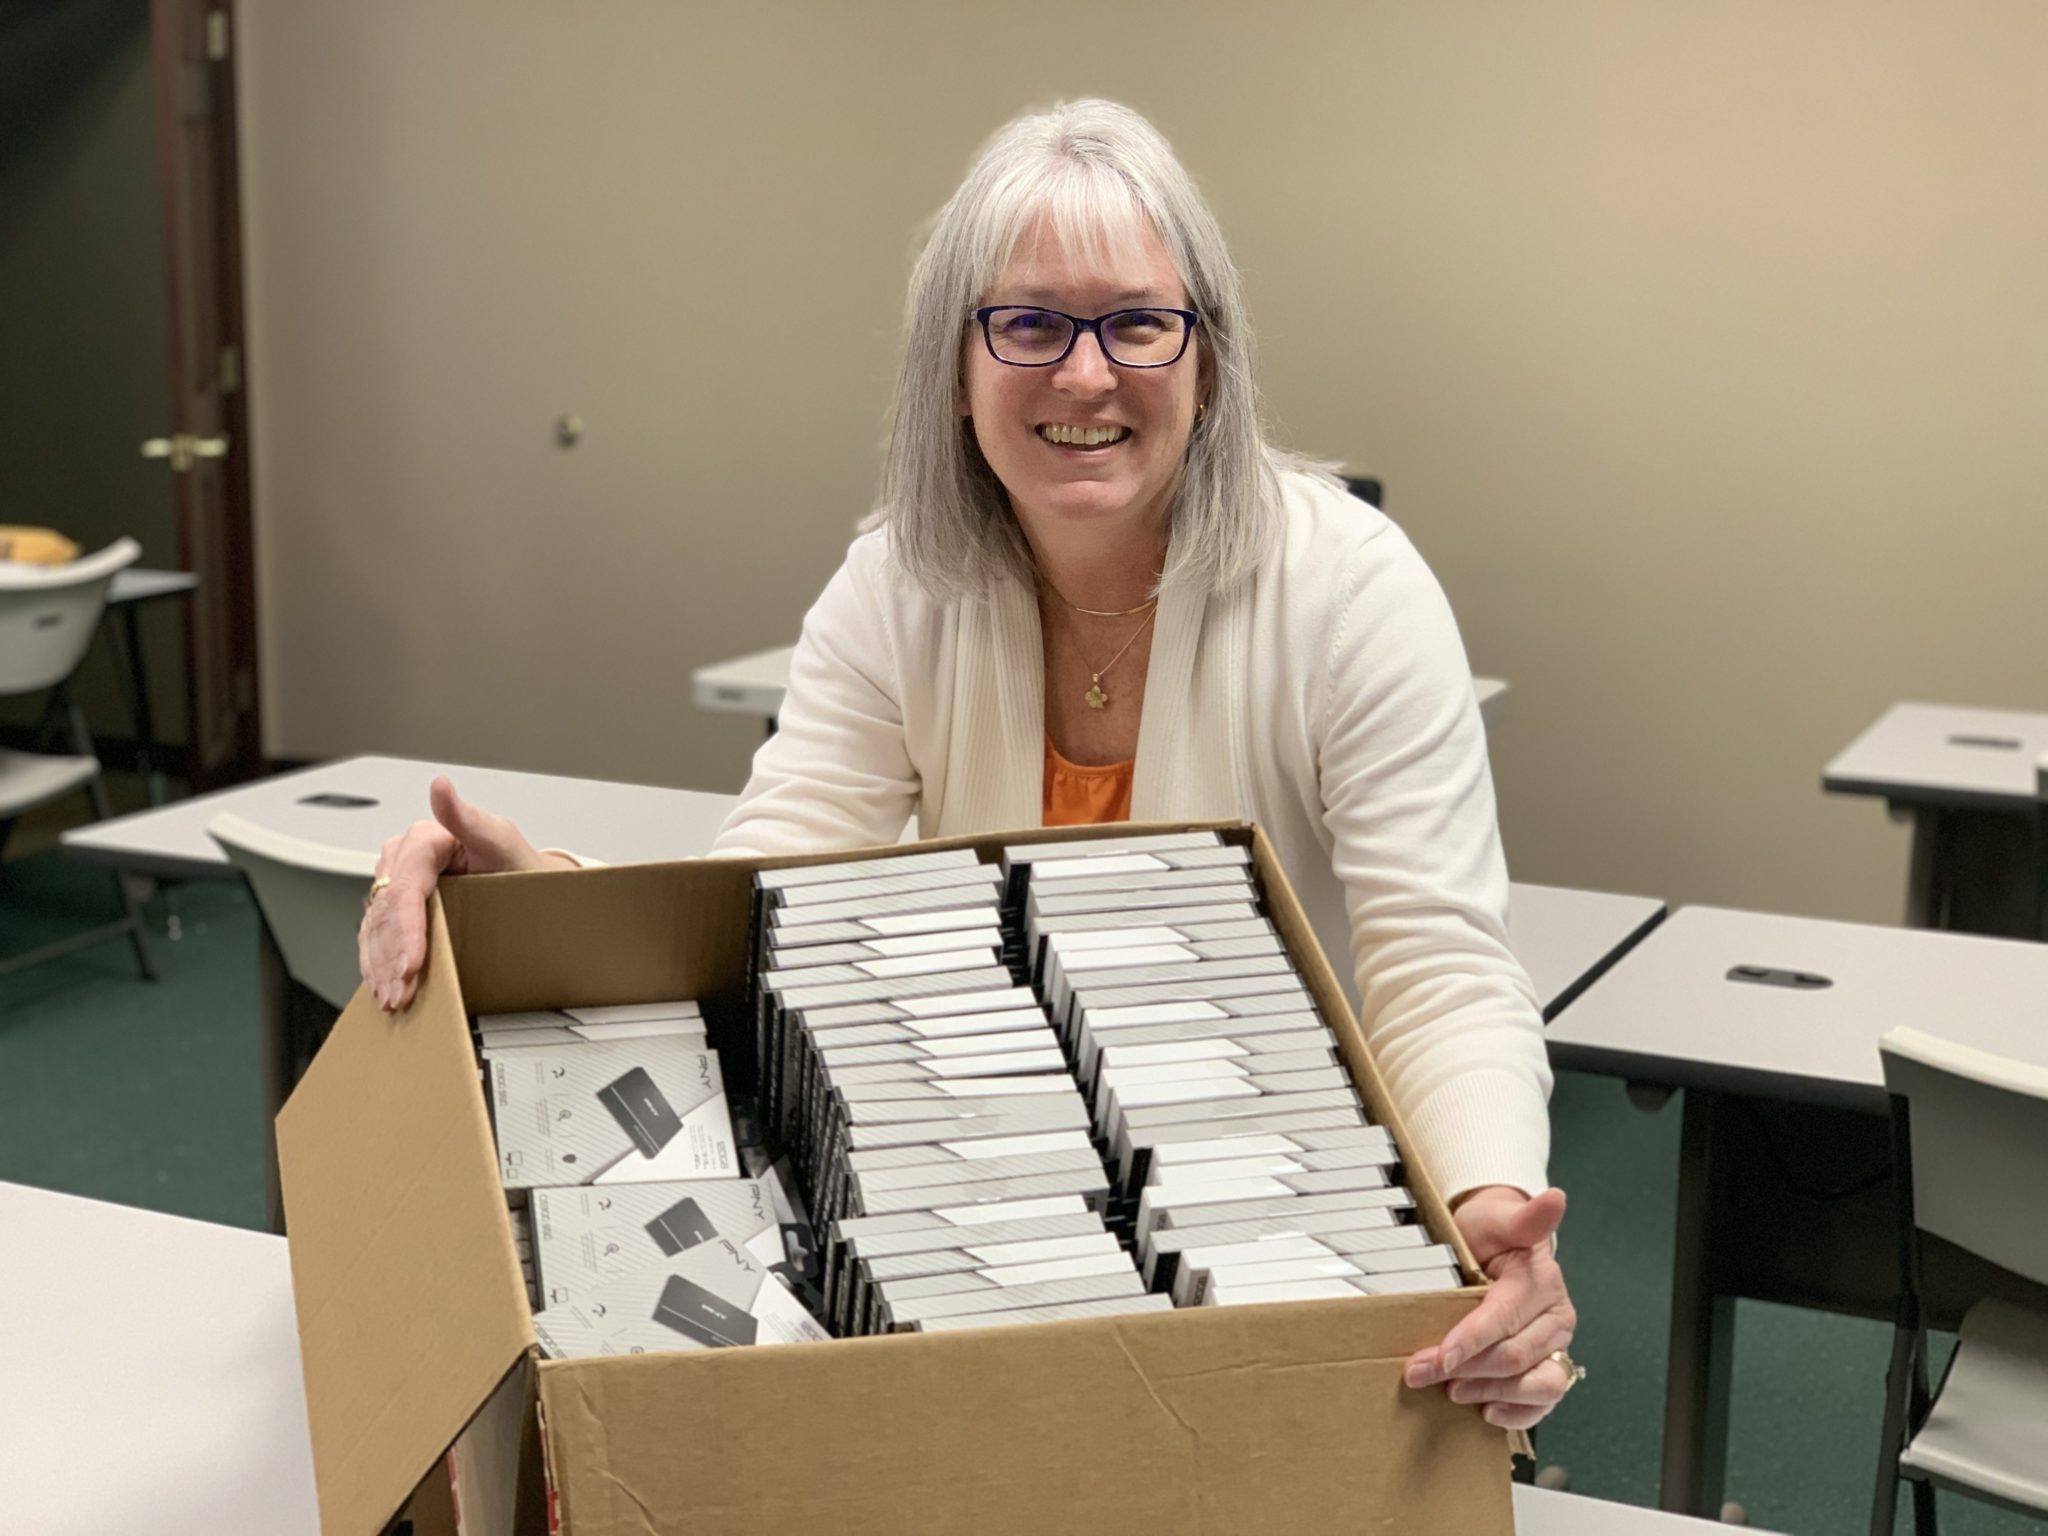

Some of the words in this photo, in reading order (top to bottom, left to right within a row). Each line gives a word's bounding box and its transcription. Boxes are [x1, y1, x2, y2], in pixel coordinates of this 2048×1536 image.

[696, 1054, 712, 1089] PNY
[748, 1184, 765, 1220] PNY
[717, 1239, 756, 1272] PNY
